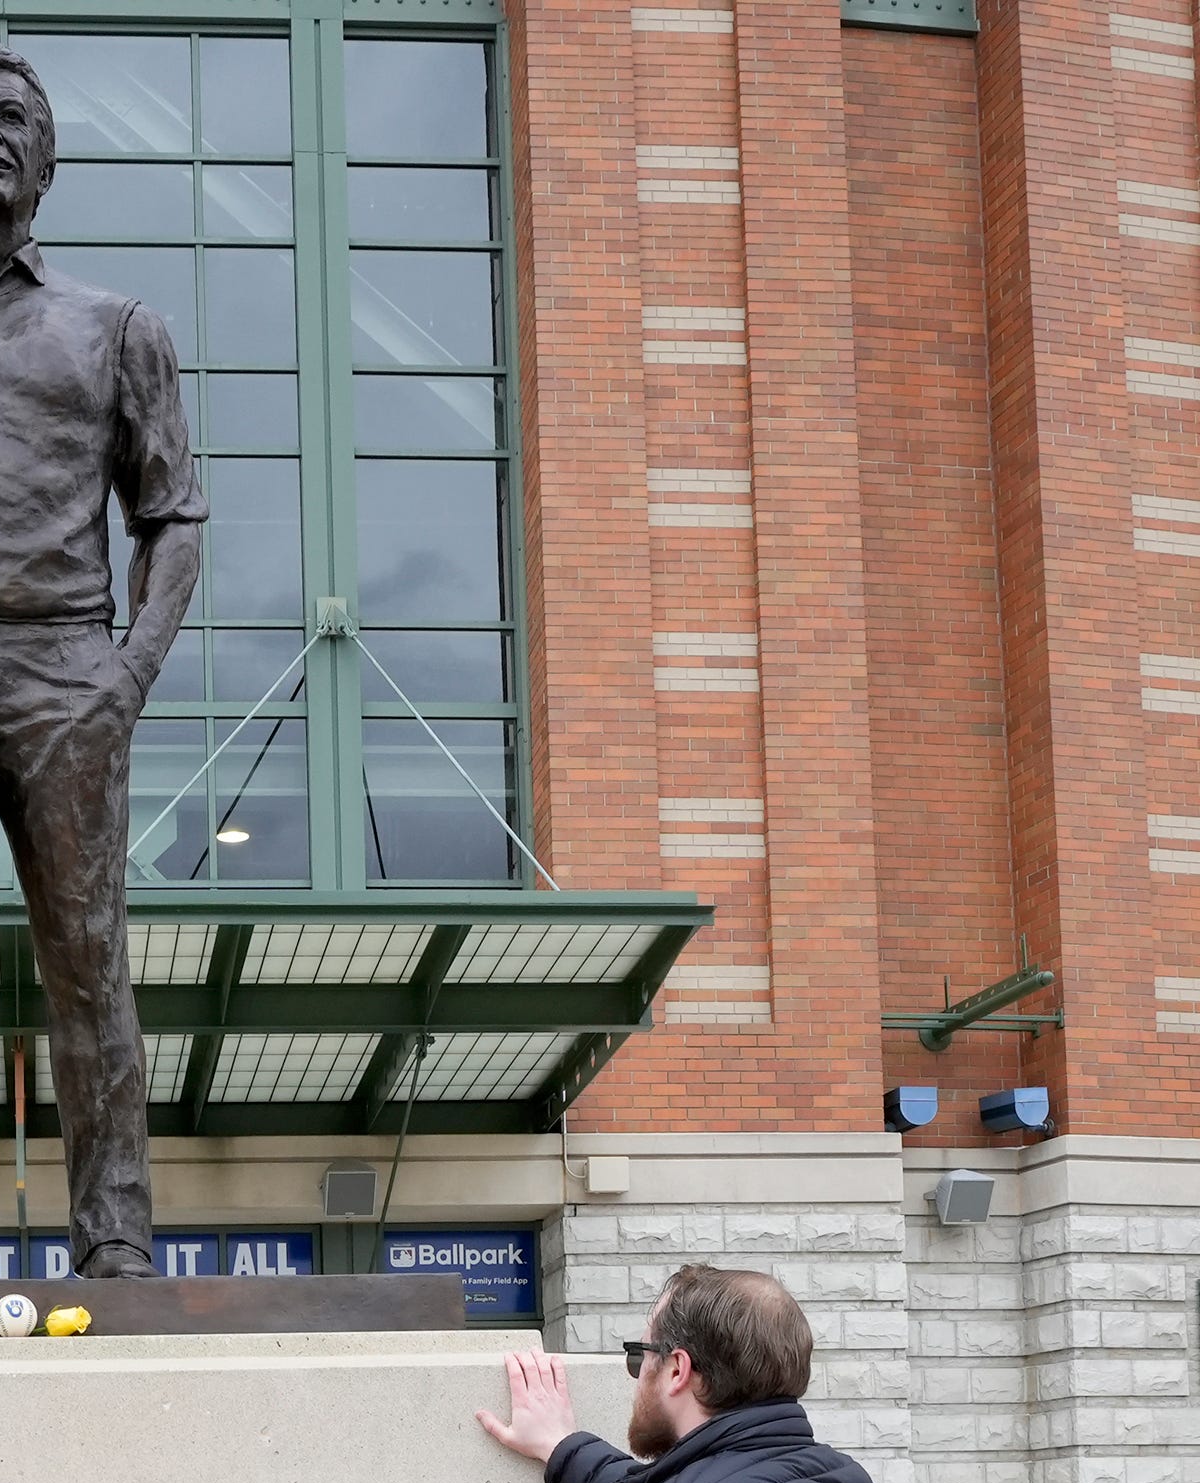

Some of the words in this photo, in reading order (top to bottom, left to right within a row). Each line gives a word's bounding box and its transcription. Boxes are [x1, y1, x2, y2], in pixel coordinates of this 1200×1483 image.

[166, 1243, 202, 1277] IT
[232, 1242, 297, 1276] ALL
[419, 1243, 523, 1270] Ballpark
[468, 1277, 492, 1286] Family
[512, 1277, 528, 1286] App
